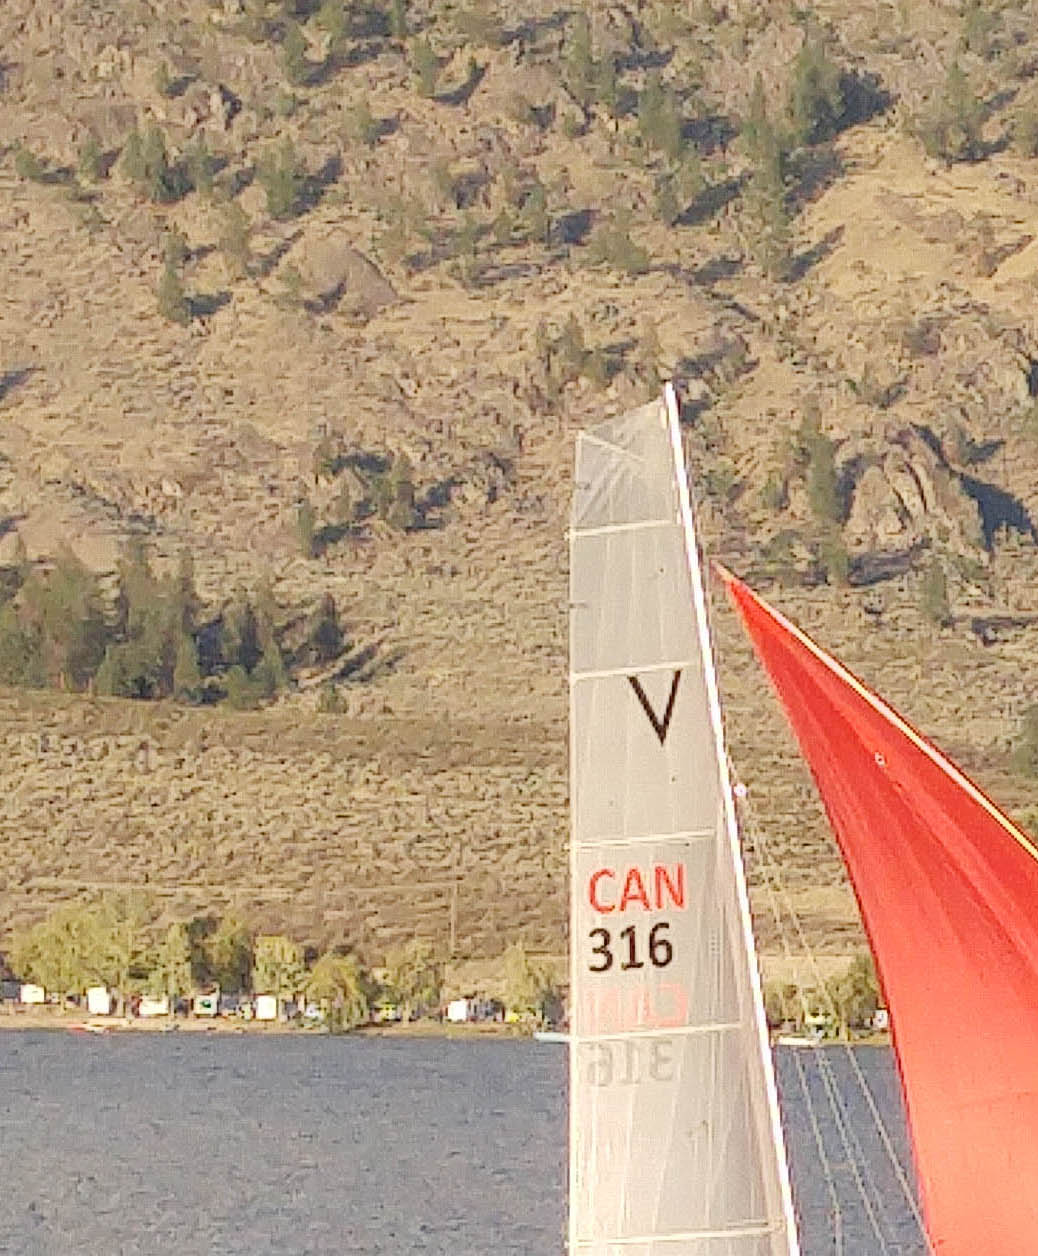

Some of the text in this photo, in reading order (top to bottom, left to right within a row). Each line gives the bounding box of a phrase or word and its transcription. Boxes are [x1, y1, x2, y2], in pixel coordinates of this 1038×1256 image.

[627, 669, 682, 746] V
[588, 862, 686, 914] CAN
[588, 922, 673, 972] 316
